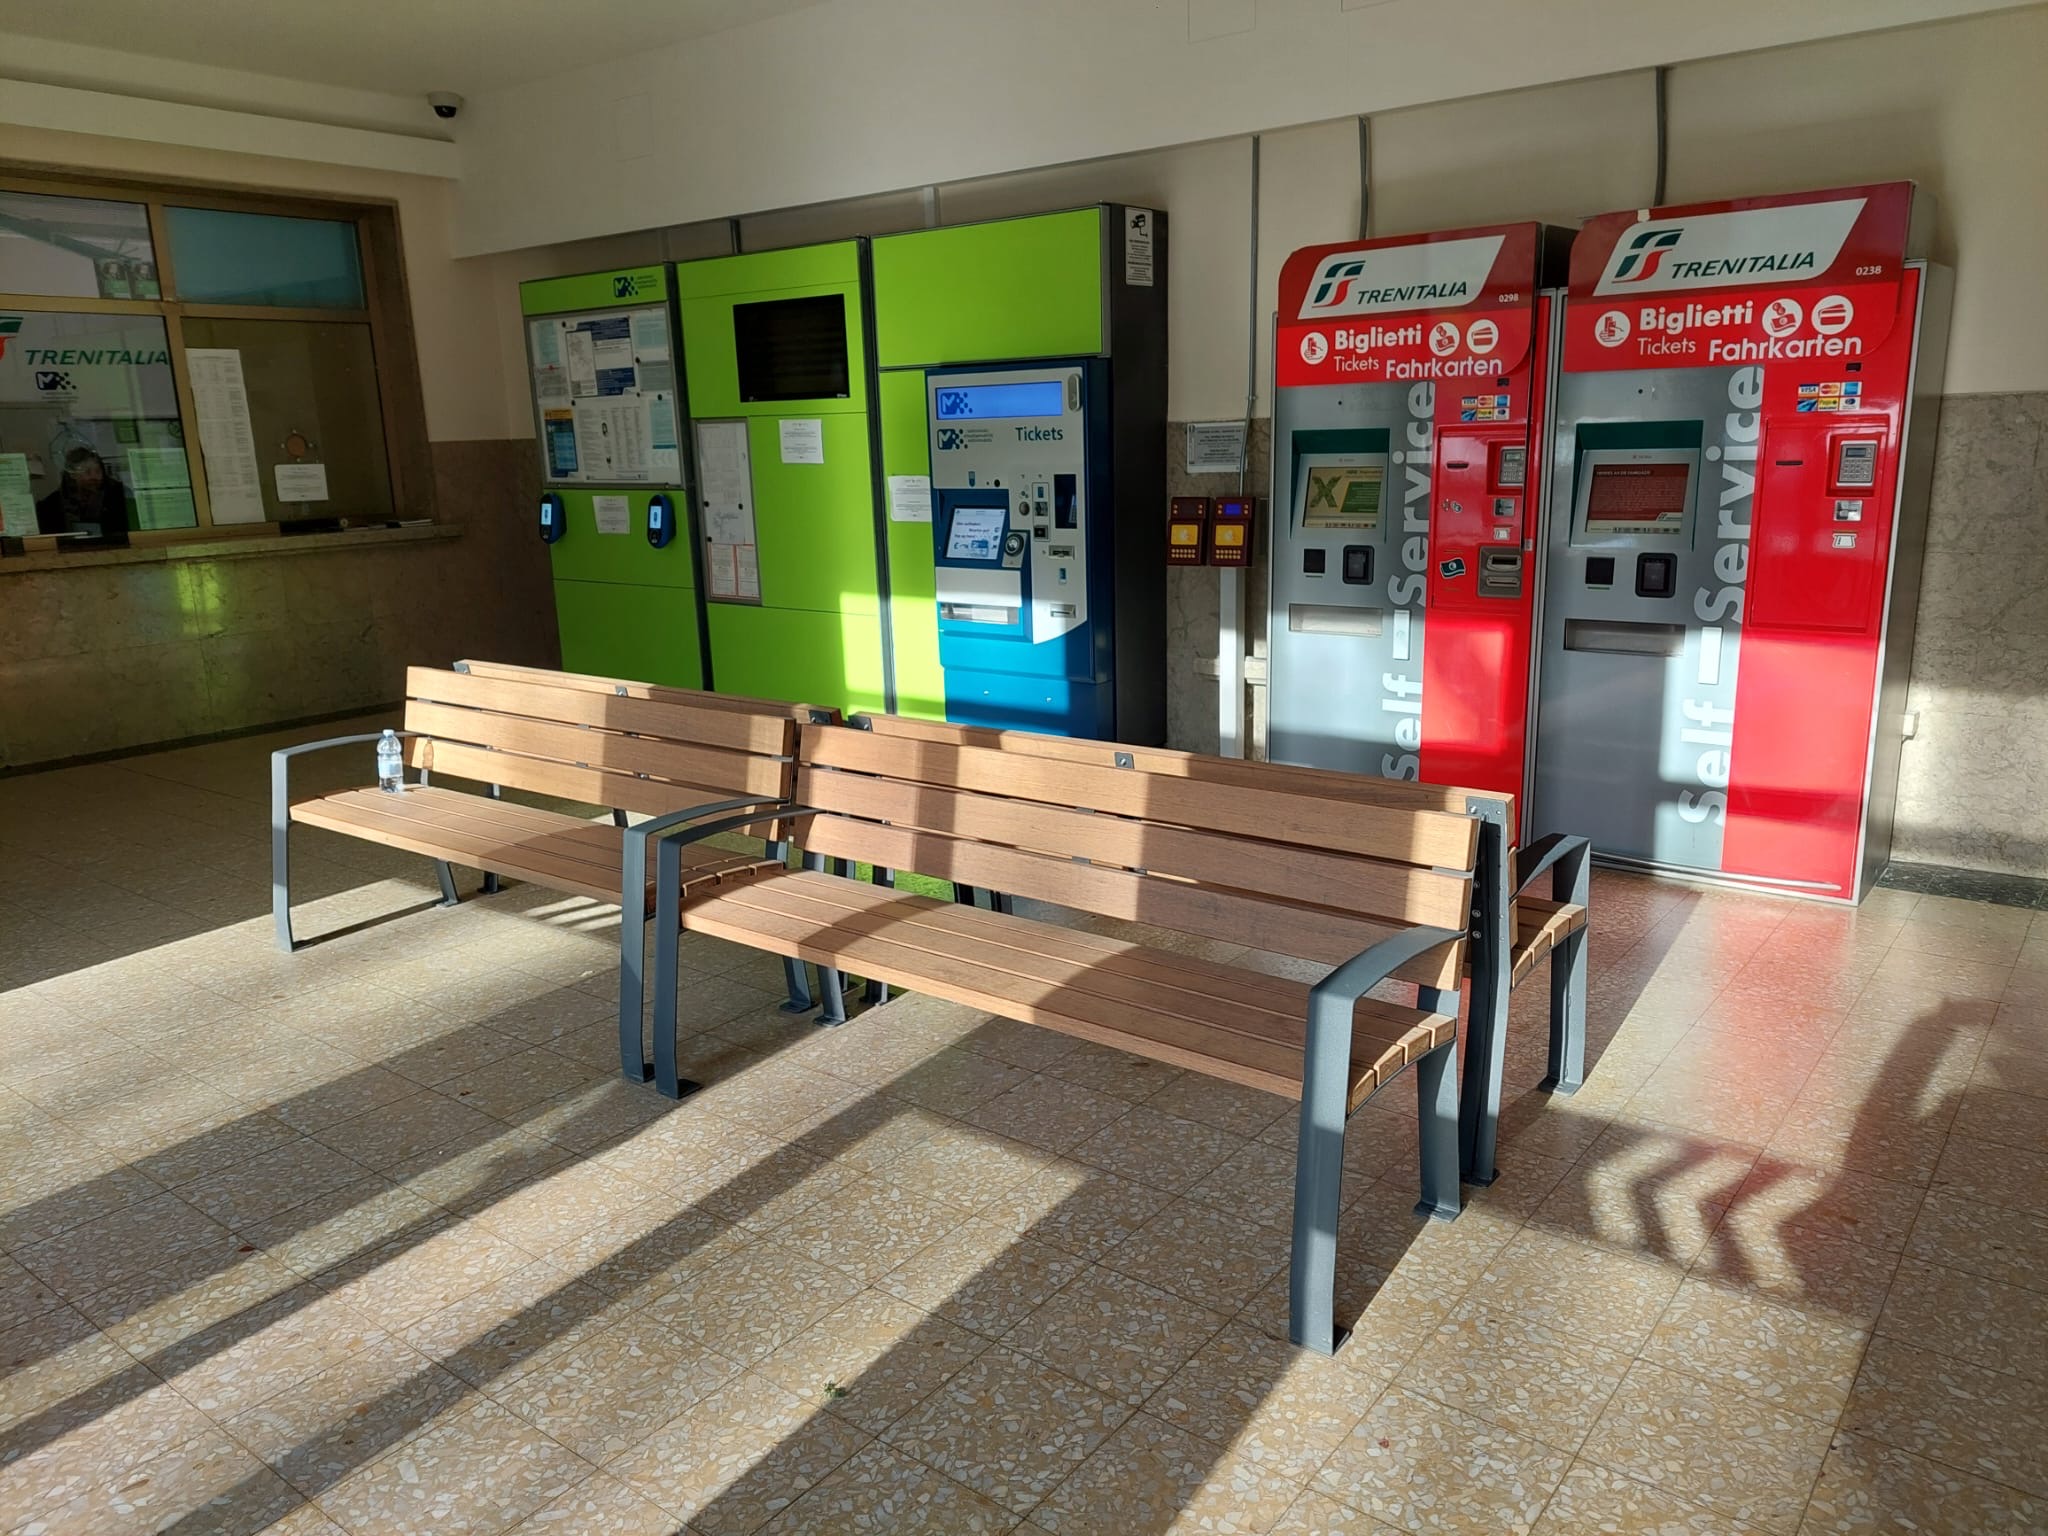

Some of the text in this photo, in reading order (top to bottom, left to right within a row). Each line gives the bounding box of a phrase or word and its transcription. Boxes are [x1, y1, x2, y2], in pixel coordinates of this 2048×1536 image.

[1672, 252, 1814, 279] TRENITALIA
[1855, 265, 1882, 276] 0238
[1357, 281, 1468, 305] TRENITALIA
[1498, 293, 1519, 302] 0298
[1639, 300, 1753, 335] Biglietti
[1334, 324, 1422, 354] Biglietti
[1638, 335, 1862, 361] Tickets Fahrkarten
[25, 349, 169, 366] TRENITALIA
[1333, 354, 1502, 379] Tickets Fahrkarten
[1015, 425, 1064, 441] Tickets
